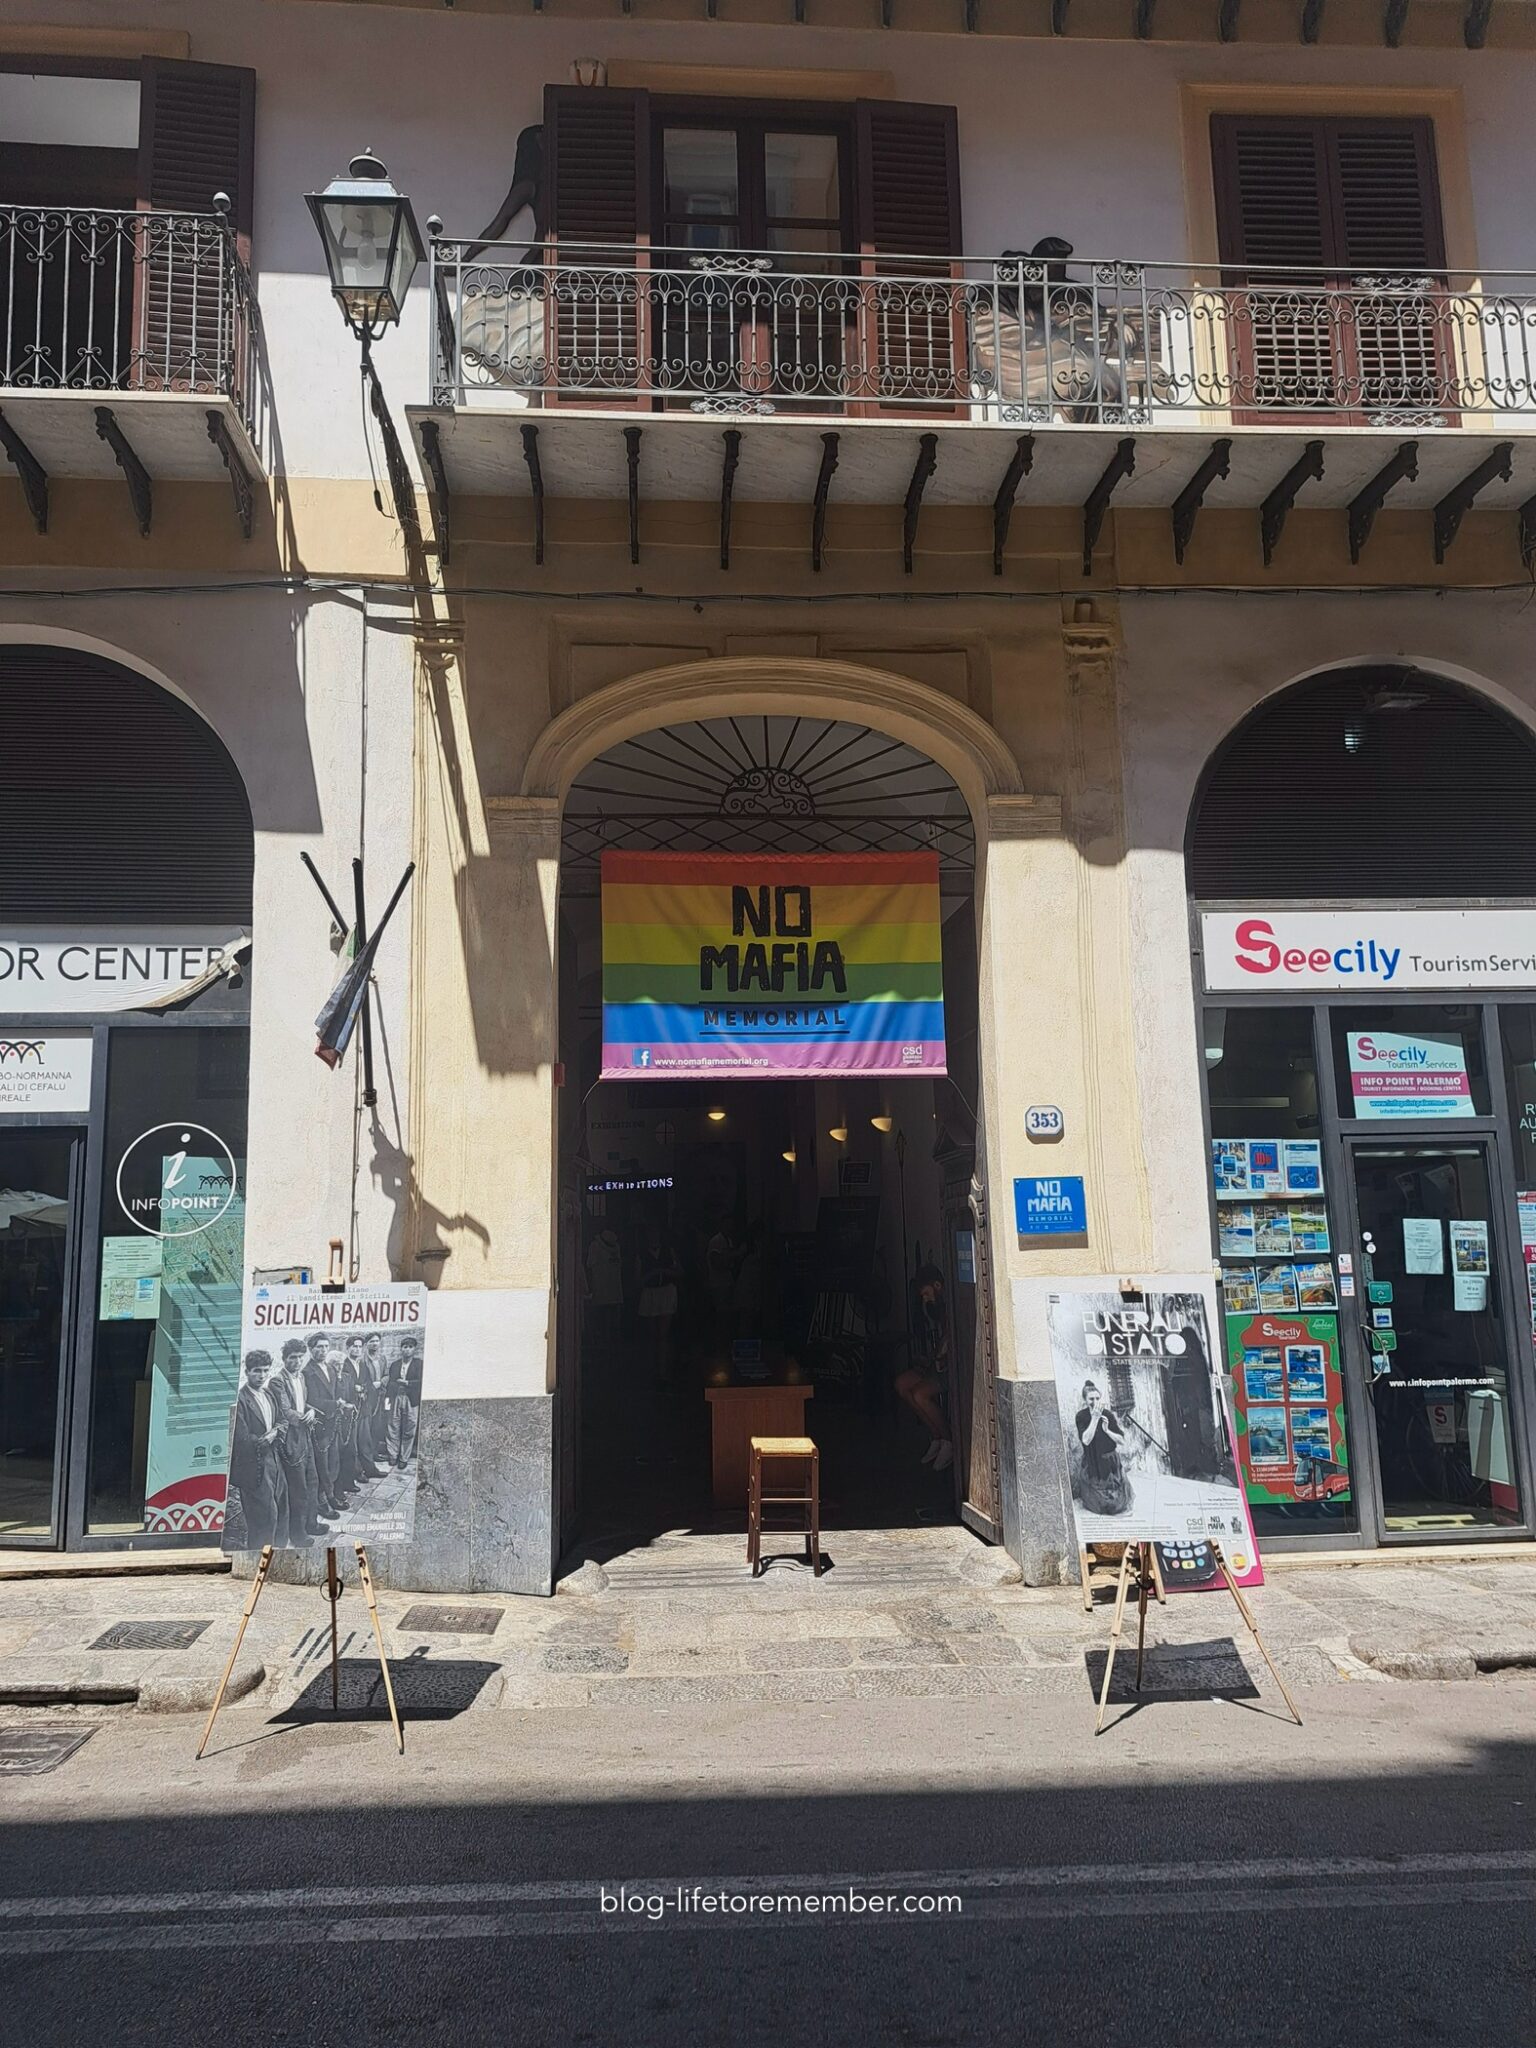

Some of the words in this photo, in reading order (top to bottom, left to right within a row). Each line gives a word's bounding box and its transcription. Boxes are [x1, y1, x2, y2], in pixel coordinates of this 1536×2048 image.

[732, 885, 812, 938] NO
[1234, 919, 1401, 980] Seecily
[699, 940, 848, 993] MAFIA
[703, 1008, 846, 1027] MEMORIAL
[902, 1043, 923, 1056] csd
[1357, 1037, 1427, 1064] Seecily
[654, 1056, 769, 1067] www.nomafiamemorial.org
[1387, 1061, 1419, 1069] Tourism
[1426, 1061, 1458, 1069] Services
[17, 1082, 28, 1091] DI
[1360, 1077, 1384, 1086] INFO
[1385, 1077, 1415, 1086] POINT
[1416, 1076, 1461, 1086] PALERMO
[1031, 1112, 1059, 1128] 353
[1035, 1180, 1061, 1197] NO
[1027, 1197, 1073, 1212] MAFIA
[254, 1302, 334, 1326] SICILIAN
[341, 1301, 419, 1324] BANDITS
[1081, 1311, 1183, 1332] FUNERALI
[1262, 1322, 1301, 1338] Seecily
[1084, 1333, 1107, 1356] DI
[1111, 1333, 1187, 1356] STATO
